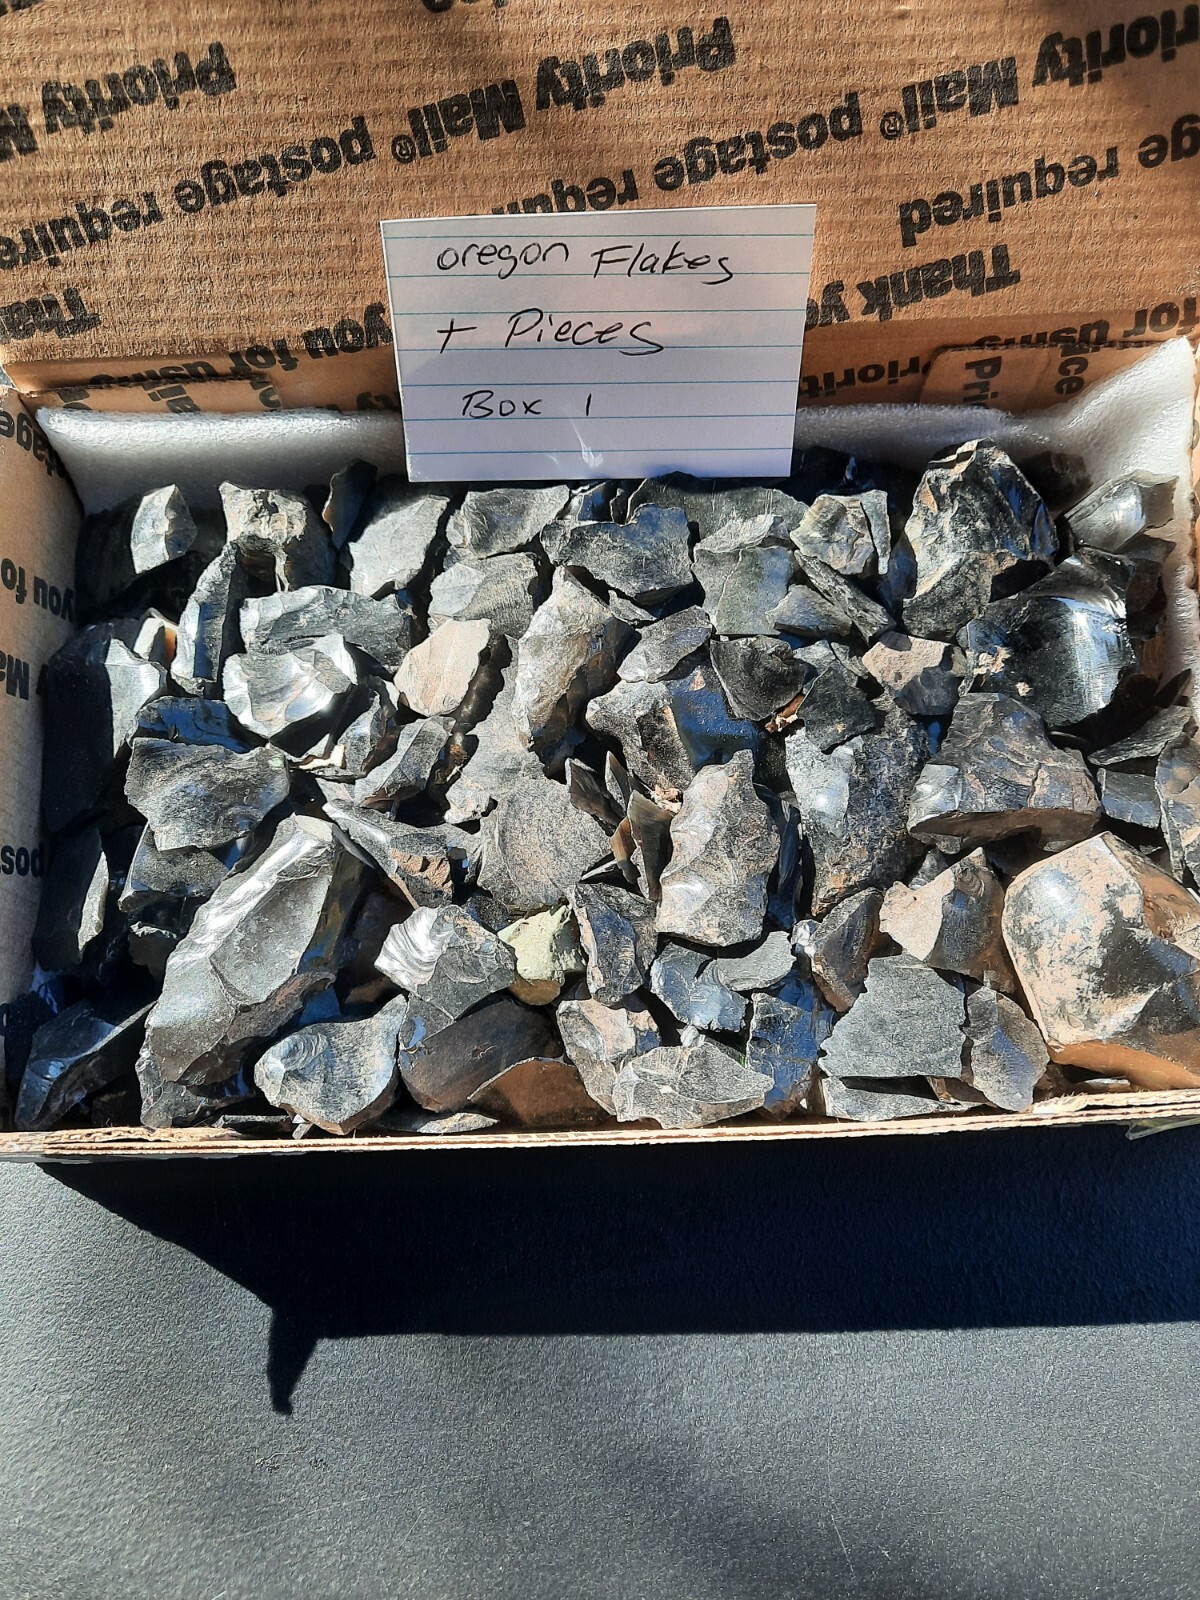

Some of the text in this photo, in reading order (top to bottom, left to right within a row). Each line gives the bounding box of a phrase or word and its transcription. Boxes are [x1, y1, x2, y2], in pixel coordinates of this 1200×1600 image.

[41, 41, 237, 135] Priority
[535, 16, 736, 112] Priority
[174, 116, 377, 214] postage
[654, 93, 863, 192] postage
[899, 147, 1119, 248] required
[590, 240, 734, 285] Flakes
[856, 244, 1021, 322] Thank
[230, 339, 298, 372] for
[504, 307, 665, 356] Pieces
[1122, 298, 1200, 339] for
[461, 389, 543, 419] Box
